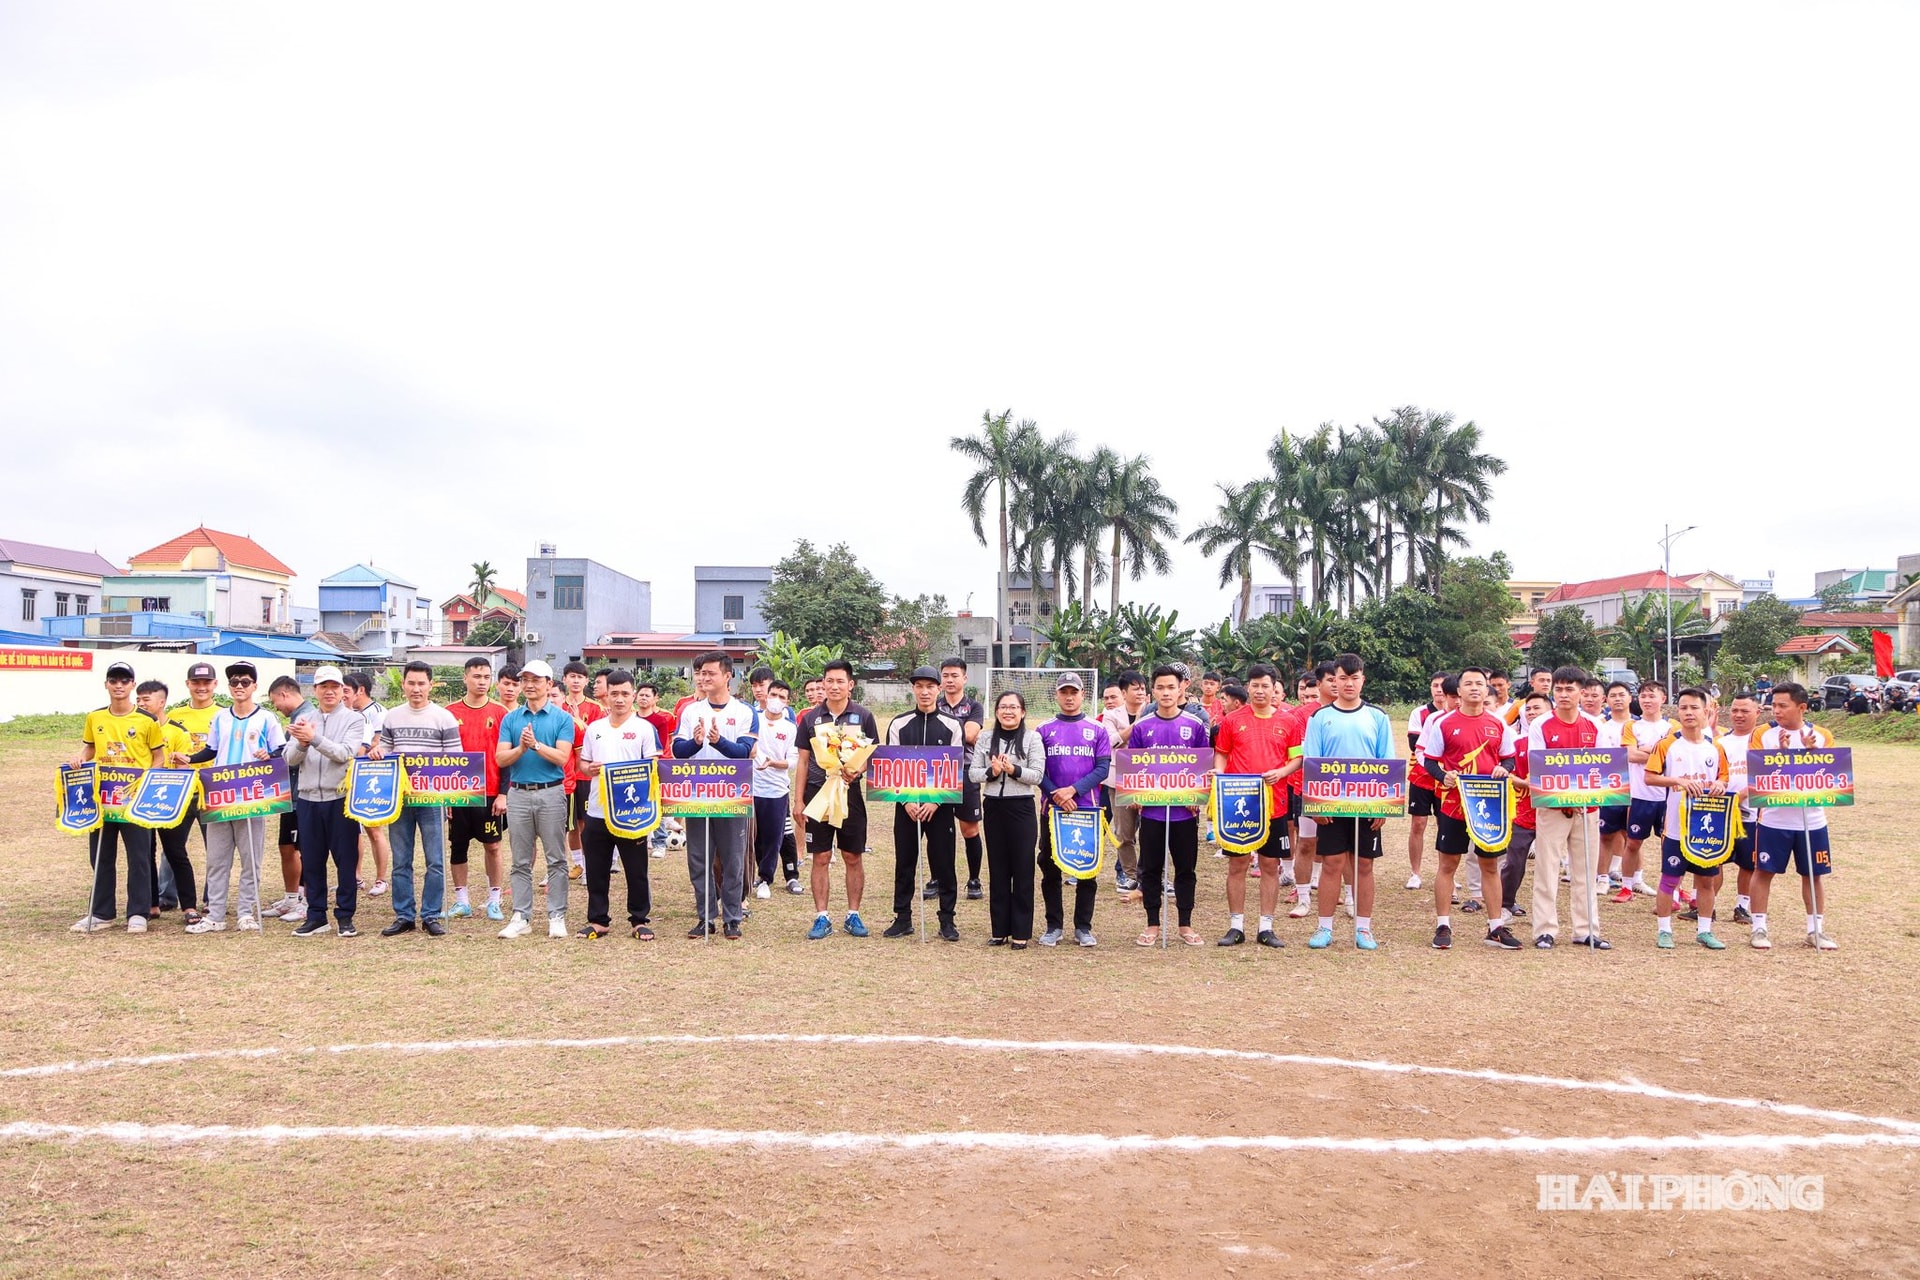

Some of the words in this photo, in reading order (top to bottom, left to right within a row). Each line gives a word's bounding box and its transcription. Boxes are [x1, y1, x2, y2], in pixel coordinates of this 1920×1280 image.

[394, 728, 434, 738] SALTY
[1048, 742, 1070, 756] GIẾNG
[1073, 744, 1094, 757] CHÙA
[406, 756, 429, 768] ĐỘI
[433, 756, 469, 766] BÓNG
[1131, 752, 1156, 766] ĐỘI
[1160, 752, 1198, 764] BÓNG
[1545, 752, 1570, 767] ĐỘI
[1574, 752, 1612, 764] BÓNG
[1764, 752, 1790, 768] ĐỘI
[1794, 752, 1834, 764] BÓNG
[212, 768, 235, 782] ĐỘI
[238, 765, 273, 778] BÓNG
[672, 763, 696, 777] ĐỘI
[700, 764, 736, 775] BÓNG
[872, 758, 928, 794] TRỌNG
[932, 752, 958, 790] TÀI
[1320, 760, 1346, 776] ĐỘI
[1350, 762, 1389, 774] BÓNG
[101, 770, 136, 782] BÓNG
[408, 770, 430, 792] ẾN
[432, 770, 467, 792] QUỐC
[472, 776, 480, 790] 2
[1123, 768, 1155, 788] KIẾN
[1160, 768, 1196, 790] QUỐC
[1200, 774, 1208, 788] 1
[1541, 776, 1570, 790] DU
[1577, 768, 1602, 790] LỄ
[1609, 774, 1622, 789] 3
[1756, 769, 1790, 791] KIẾN
[1795, 768, 1834, 790] QUỐC
[1838, 775, 1848, 788] 3
[209, 788, 236, 806] DU
[242, 780, 264, 802] LỄ
[270, 782, 280, 797] 1
[661, 780, 692, 798] NGŨ
[696, 780, 735, 798] PHÚC
[741, 784, 750, 798] 2
[1308, 778, 1342, 797] NGŨ
[1346, 779, 1388, 798] PHÚC
[1393, 782, 1400, 798] 1
[408, 796, 436, 804] (THÔN
[1133, 794, 1162, 802] (THÔN
[1558, 795, 1590, 804] (THÔN
[1594, 796, 1604, 804] 3)
[1767, 796, 1798, 804] (THÔN
[221, 807, 249, 818] (THÔN
[485, 821, 496, 834] 94
[1280, 836, 1290, 850] 10
[1373, 836, 1378, 851] 1
[1816, 850, 1829, 864] 05
